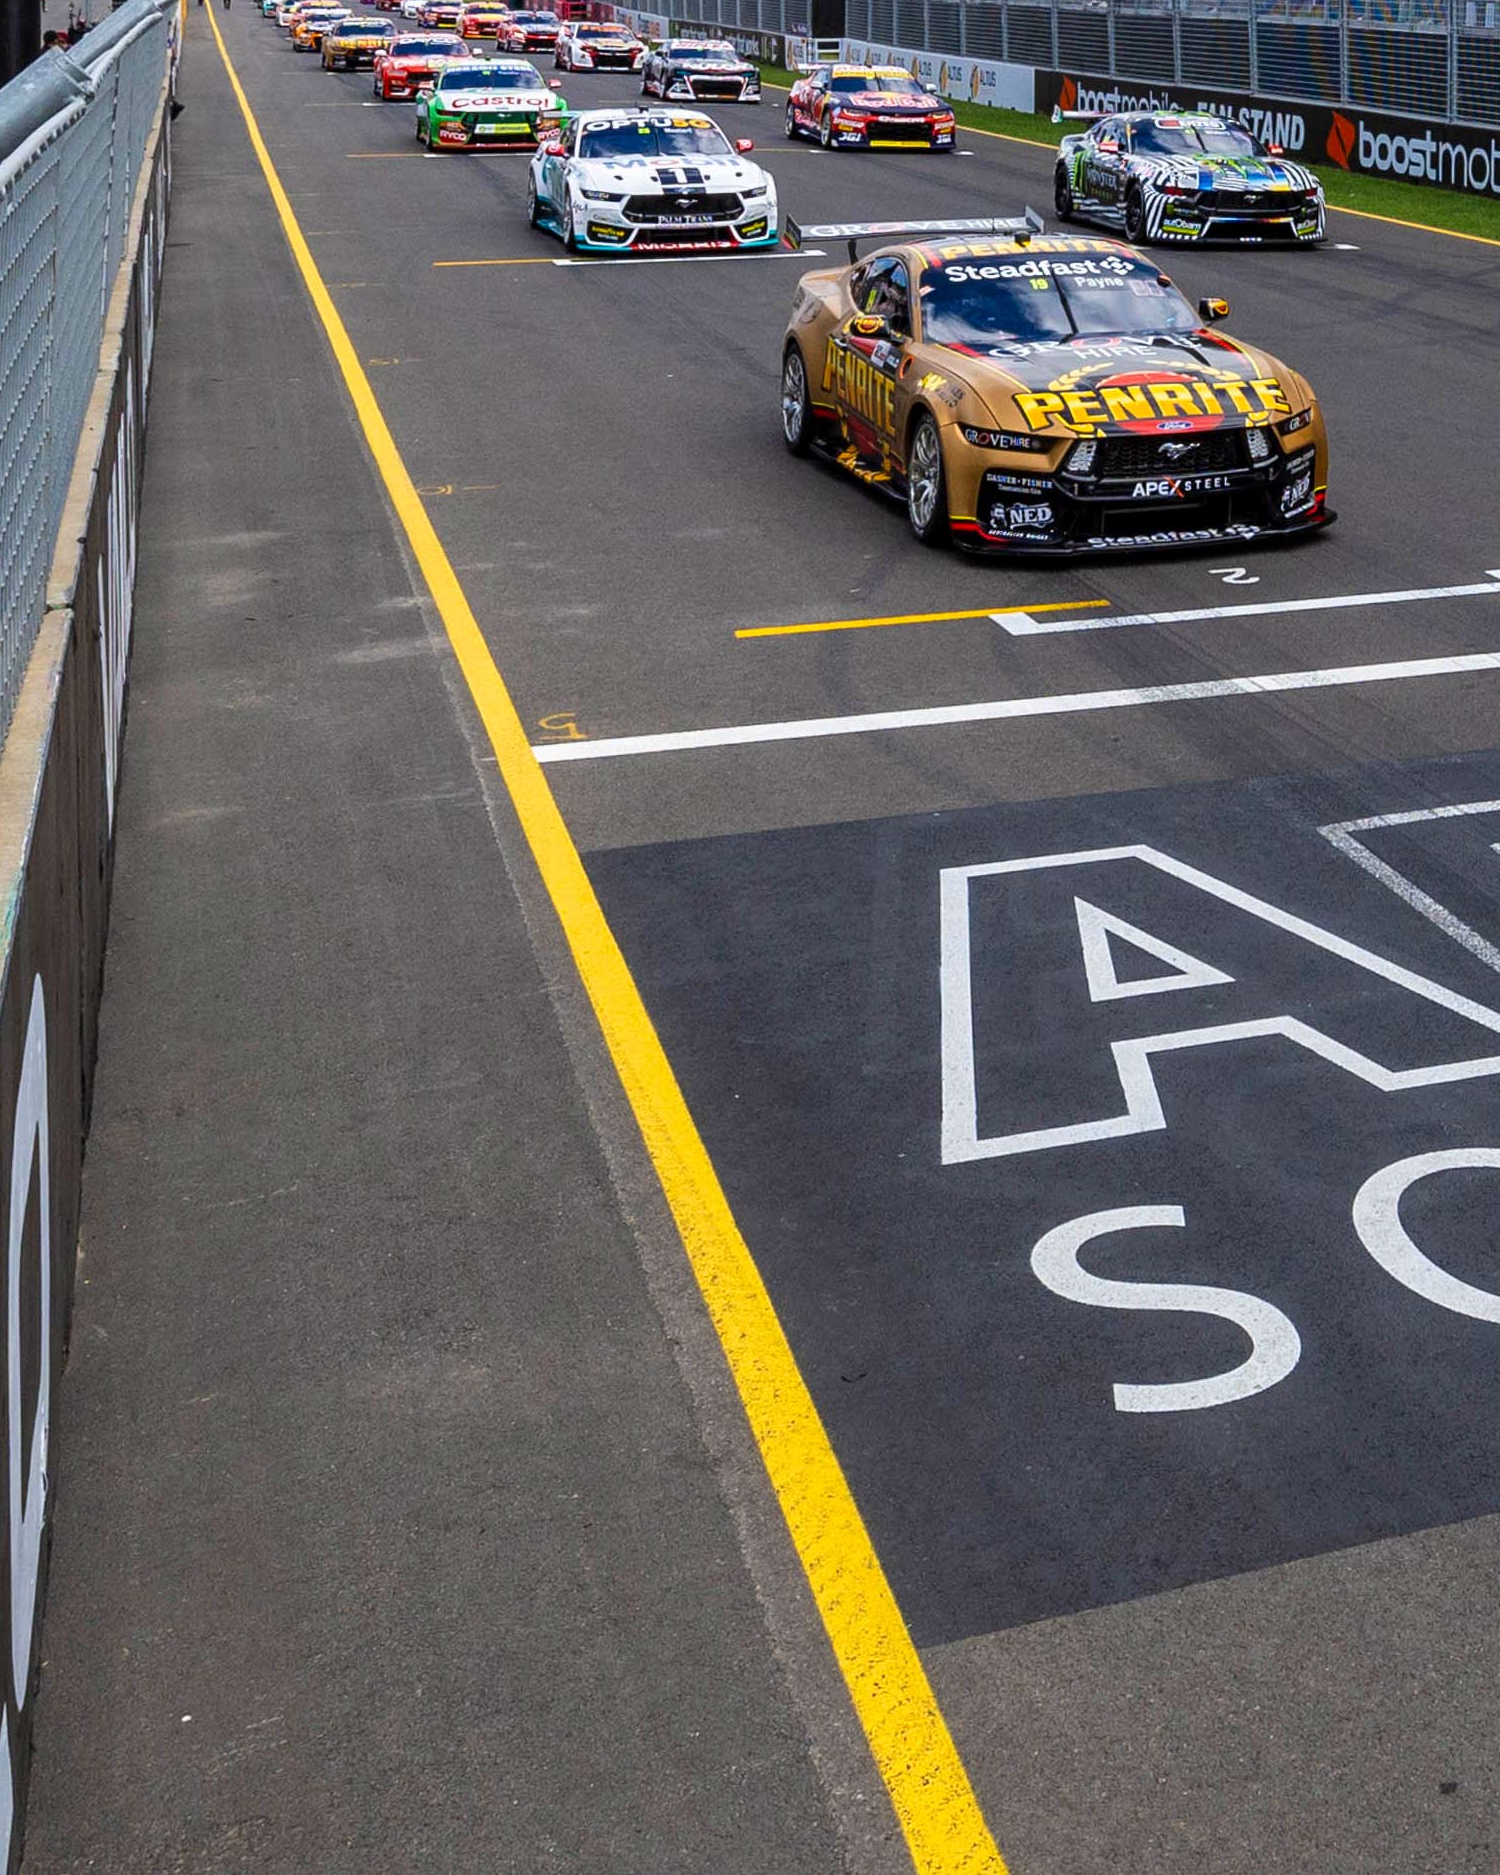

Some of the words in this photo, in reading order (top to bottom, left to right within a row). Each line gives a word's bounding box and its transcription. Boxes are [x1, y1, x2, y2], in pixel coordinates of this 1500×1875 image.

[452, 96, 549, 109] Castrol
[439, 129, 467, 141] RYCO
[669, 168, 687, 185] 1
[810, 221, 966, 238] GROVE
[942, 240, 1116, 259] PENRITE
[945, 259, 1100, 283] Steadfast
[1029, 278, 1049, 290] 19
[1074, 277, 1125, 289] Payne
[1074, 345, 1157, 359] HIRE
[822, 336, 896, 437] PENRITE
[1013, 377, 1292, 431] PENRITE
[965, 428, 1008, 448] GROVE
[1009, 436, 1031, 448] HIRE
[1132, 477, 1185, 498] APEX
[1184, 477, 1231, 492] STEEL
[1009, 505, 1052, 525] NED
